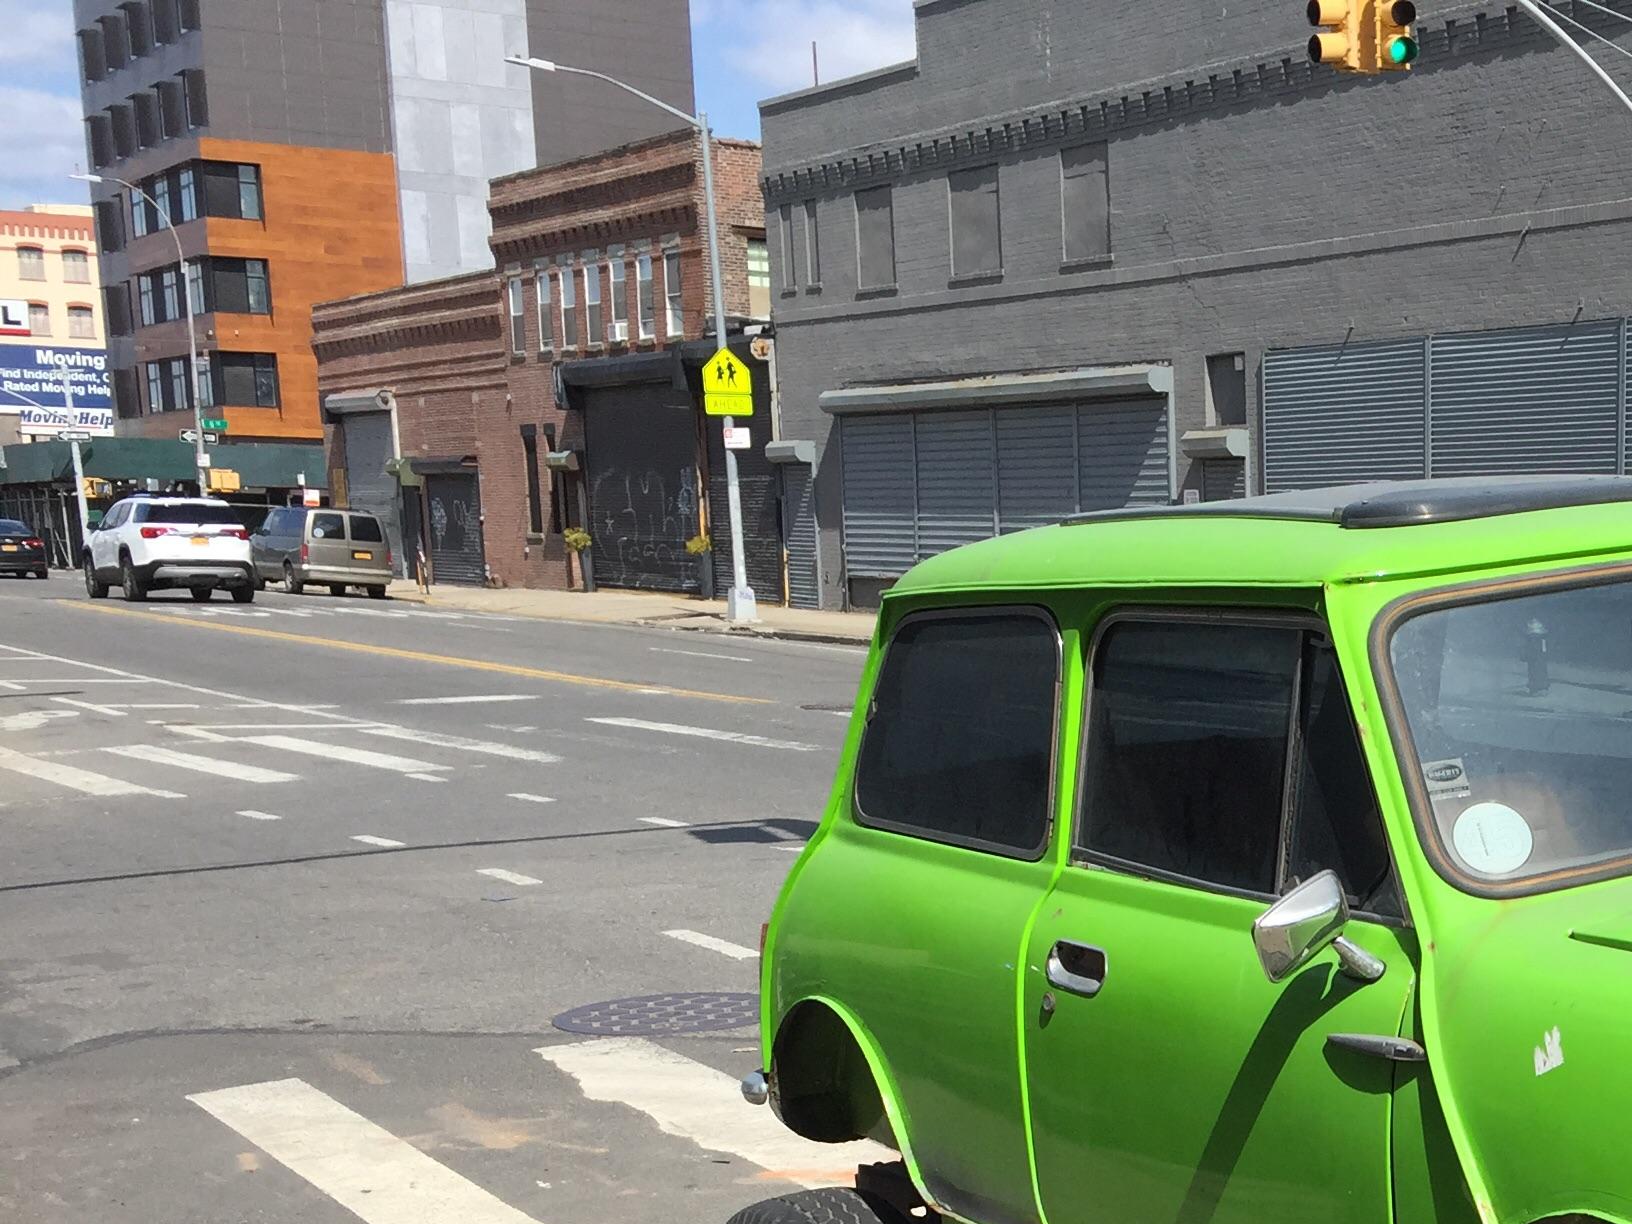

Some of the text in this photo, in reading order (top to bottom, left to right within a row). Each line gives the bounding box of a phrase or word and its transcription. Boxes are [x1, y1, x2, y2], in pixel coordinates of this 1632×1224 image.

[1, 306, 22, 326] L
[36, 349, 105, 370] Moving
[0, 367, 21, 379] ind
[22, 369, 101, 384] Indepedent,
[3, 380, 40, 393] Rated
[41, 382, 86, 396] Movng
[713, 400, 745, 410] AHEAD
[20, 410, 113, 429] MovinHelp
